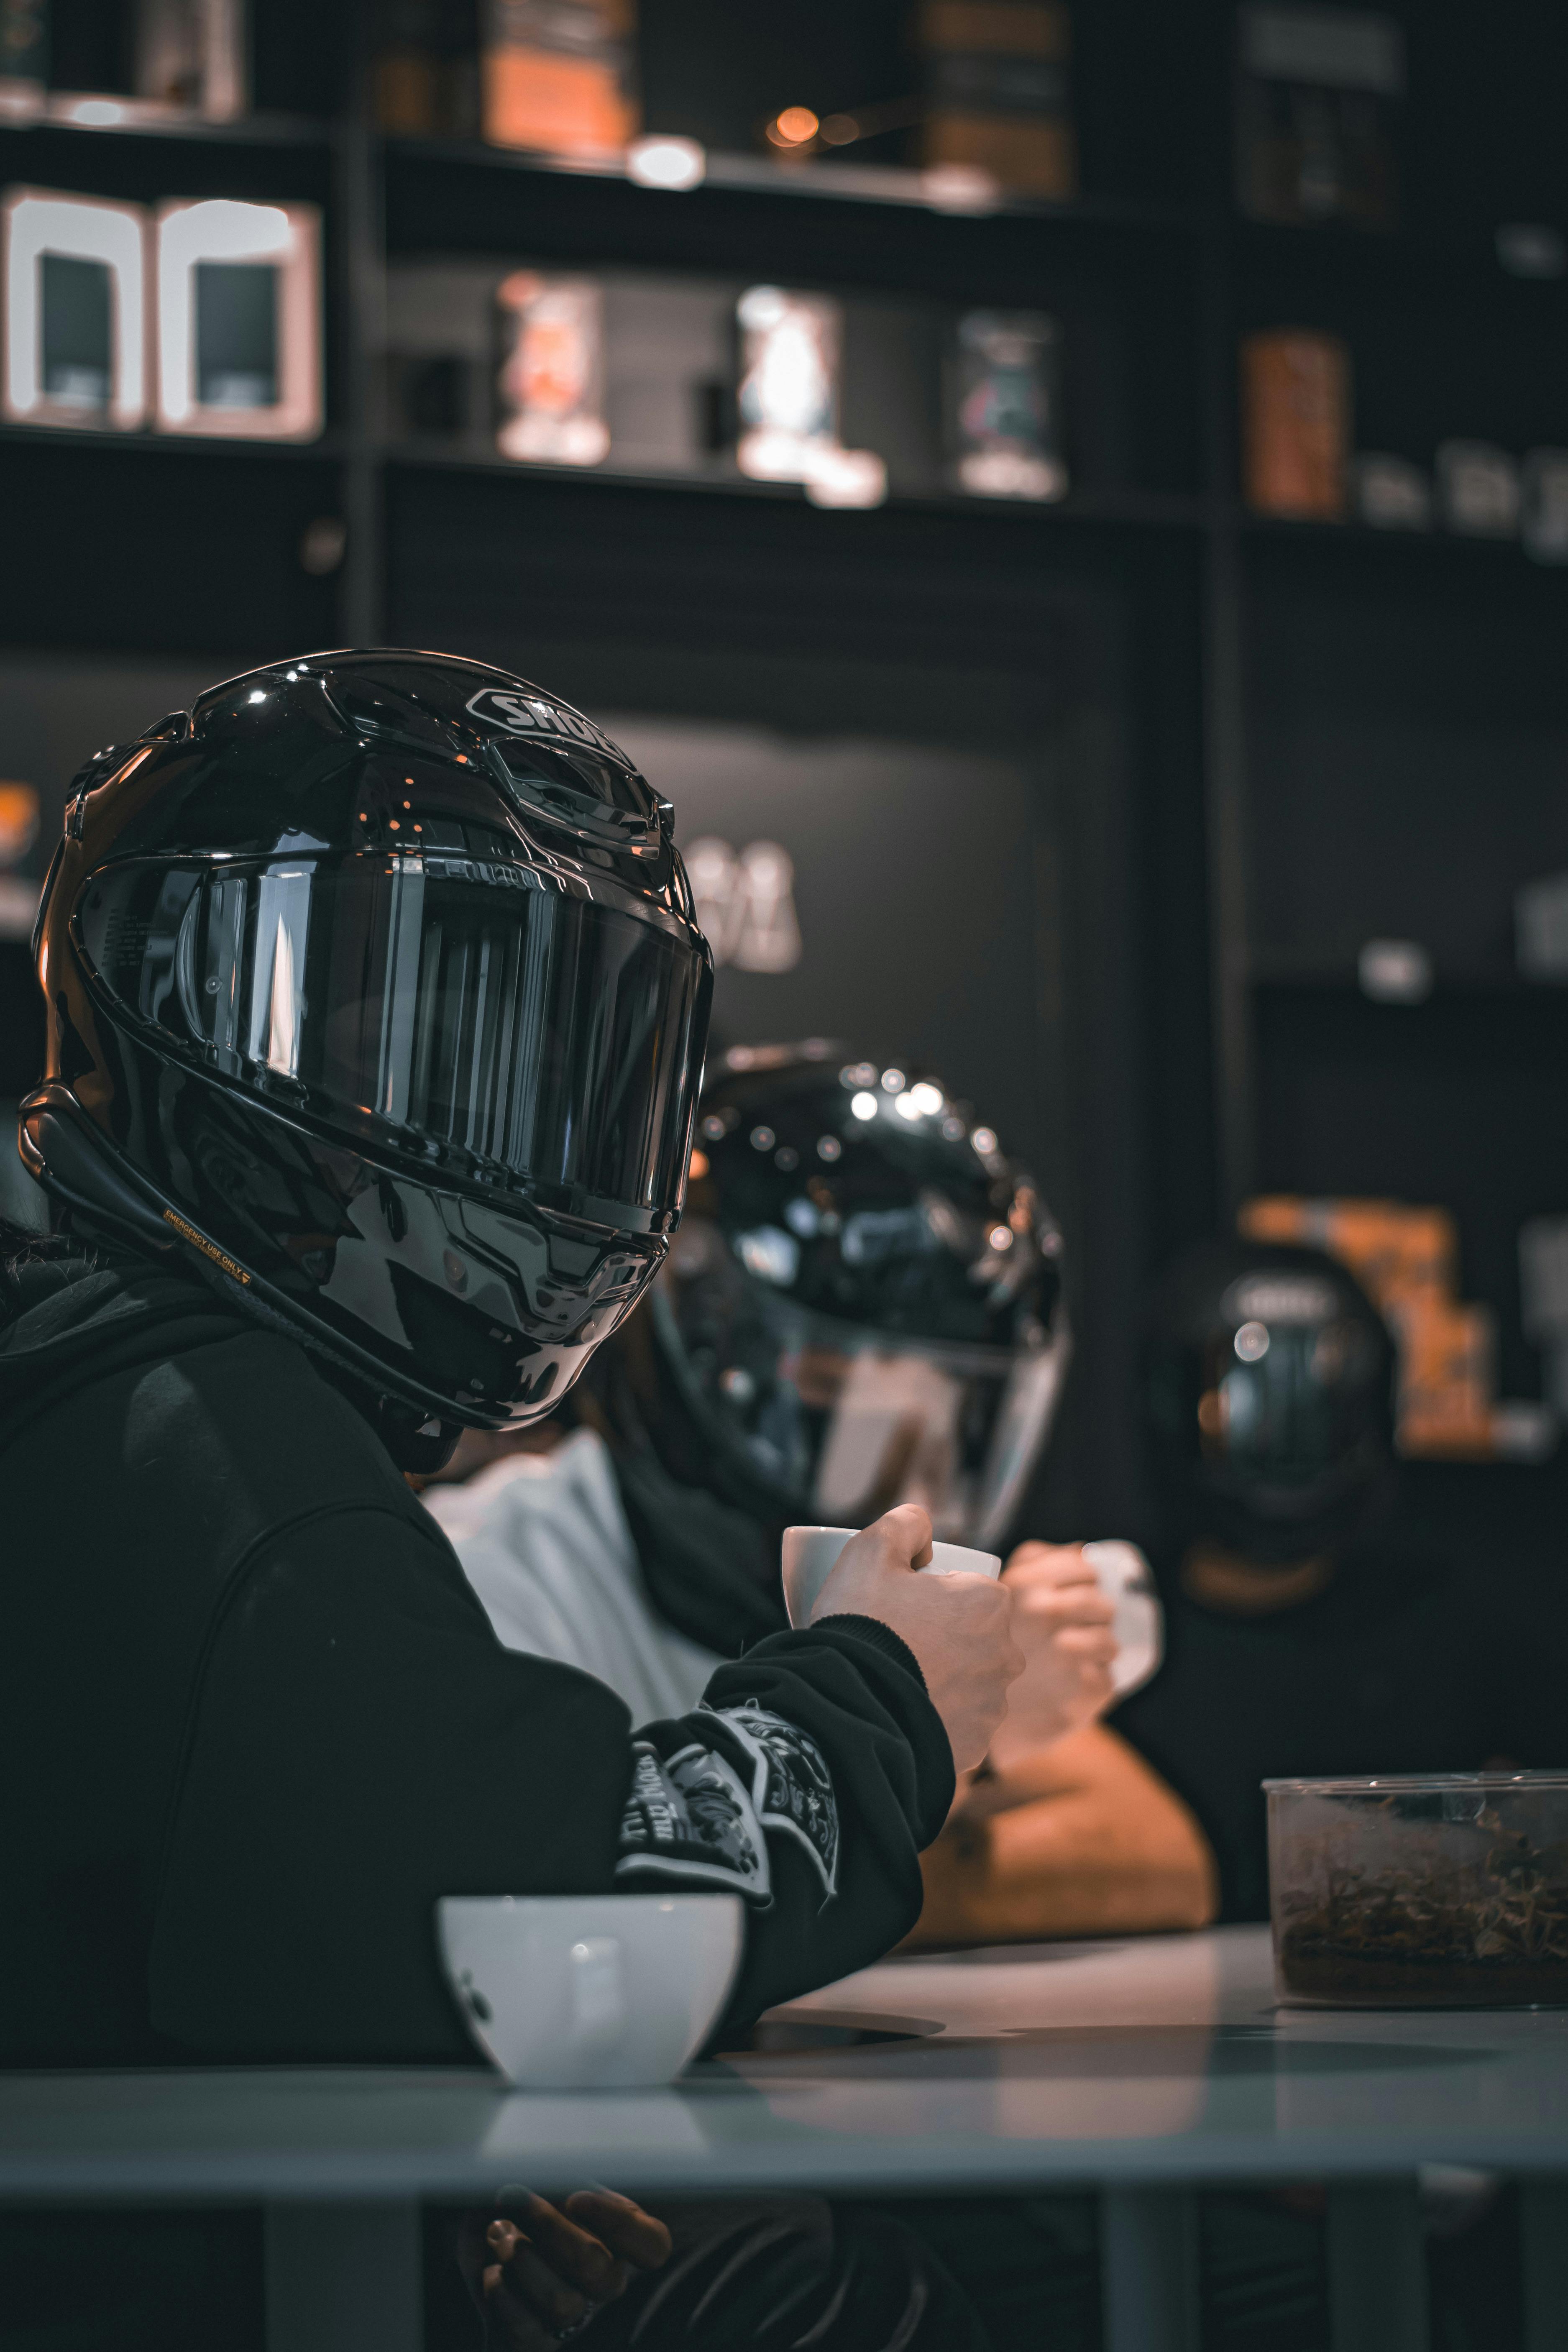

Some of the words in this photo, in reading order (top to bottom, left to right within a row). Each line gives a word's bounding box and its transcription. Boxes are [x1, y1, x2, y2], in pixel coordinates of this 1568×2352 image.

[166, 1209, 207, 1245] EMERGENCY
[207, 1244, 222, 1258] USE
[222, 1256, 242, 1274] ONLY
[231, 1270, 242, 1280] PAD
